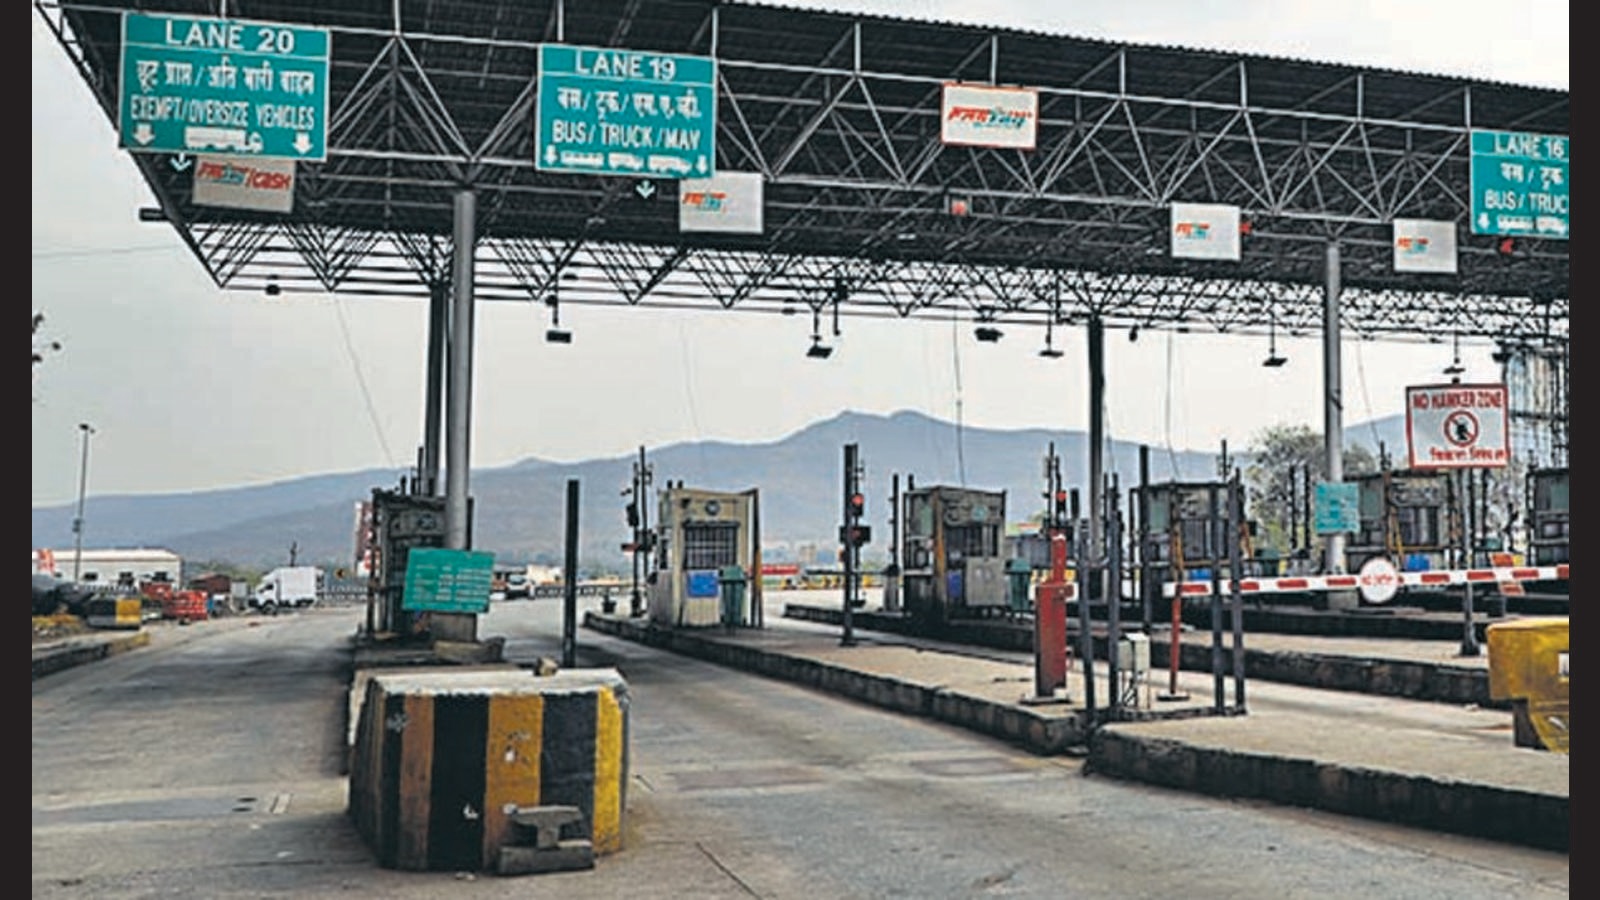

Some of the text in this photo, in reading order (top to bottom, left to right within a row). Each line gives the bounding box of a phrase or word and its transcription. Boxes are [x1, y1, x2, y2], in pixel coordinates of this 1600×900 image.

[165, 19, 295, 53] LANE 20
[575, 48, 676, 81] LANE 19
[256, 103, 315, 131] VEHICLES
[1494, 133, 1565, 160] LANE 16
